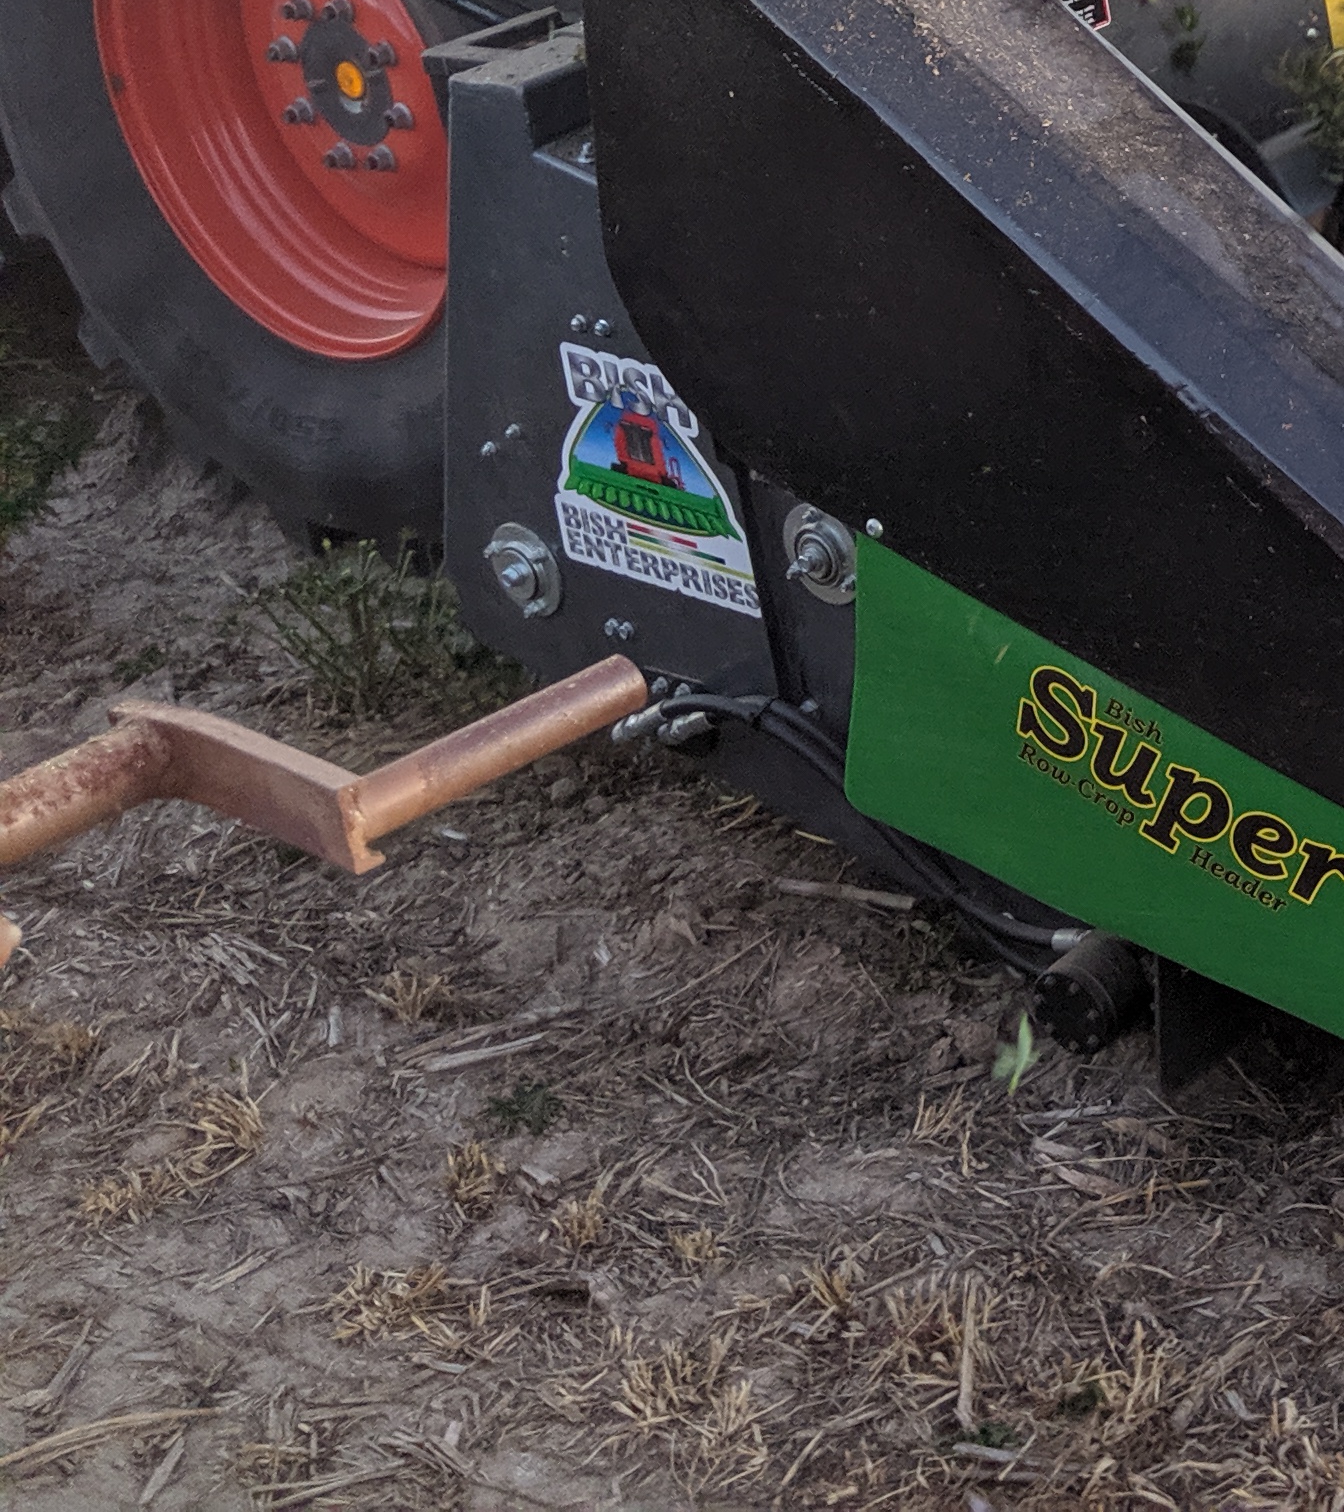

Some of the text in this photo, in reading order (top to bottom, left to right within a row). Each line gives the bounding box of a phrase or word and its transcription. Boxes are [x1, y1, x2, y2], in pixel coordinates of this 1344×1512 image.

[566, 351, 693, 429] BISH
[560, 501, 629, 545] BISH
[567, 530, 761, 610] ENTERPRISES
[1103, 697, 1163, 745] Bish
[1017, 741, 1288, 912] Row-Crop Header
